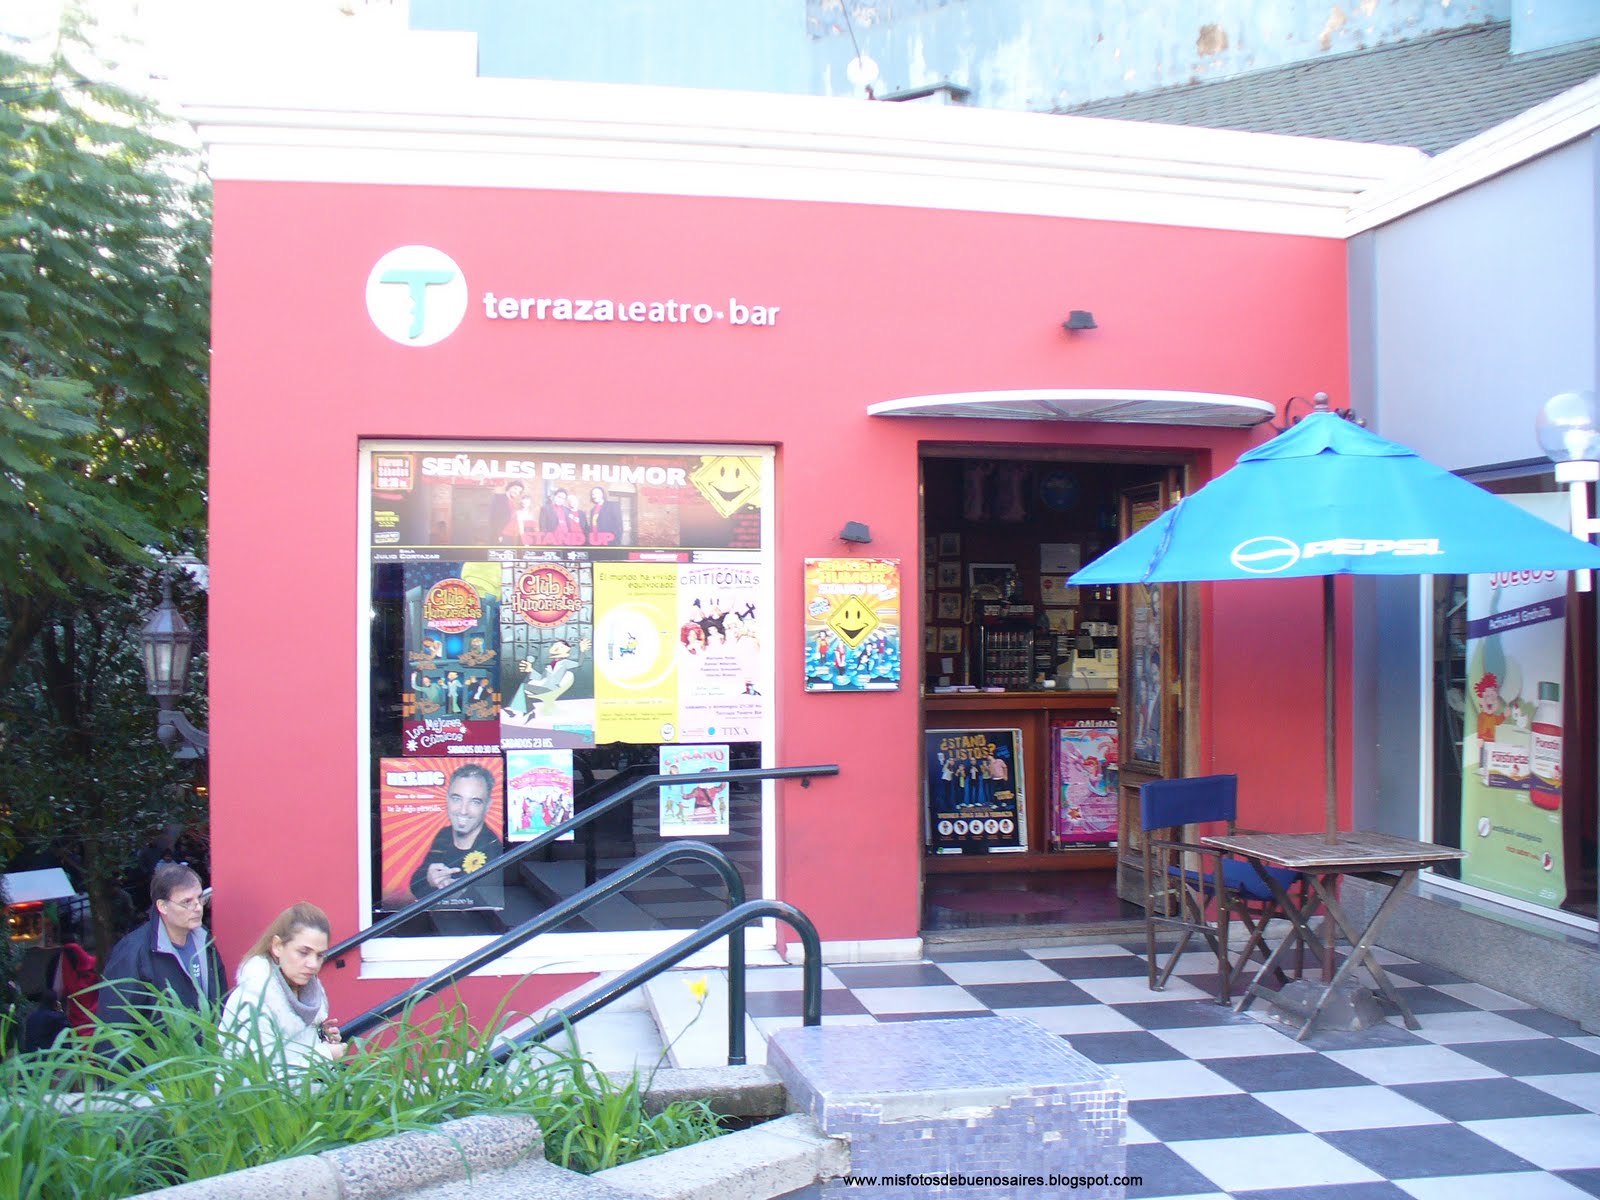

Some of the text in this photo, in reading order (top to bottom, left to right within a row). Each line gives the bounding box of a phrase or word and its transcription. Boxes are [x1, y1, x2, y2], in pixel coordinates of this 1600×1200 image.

[483, 292, 614, 321] terraza
[421, 454, 687, 486] SEÑALES DE HUMOR
[520, 531, 616, 546] STAND UP
[1301, 538, 1441, 559] PEPSI
[519, 572, 575, 595] Club de
[680, 573, 760, 586] CRITICONAS
[430, 587, 464, 606] Club
[511, 592, 583, 613] Humoristas
[423, 604, 483, 620] Humoristas
[405, 725, 426, 741] Los
[424, 717, 462, 733] Mejores
[420, 732, 464, 748] Cómicos
